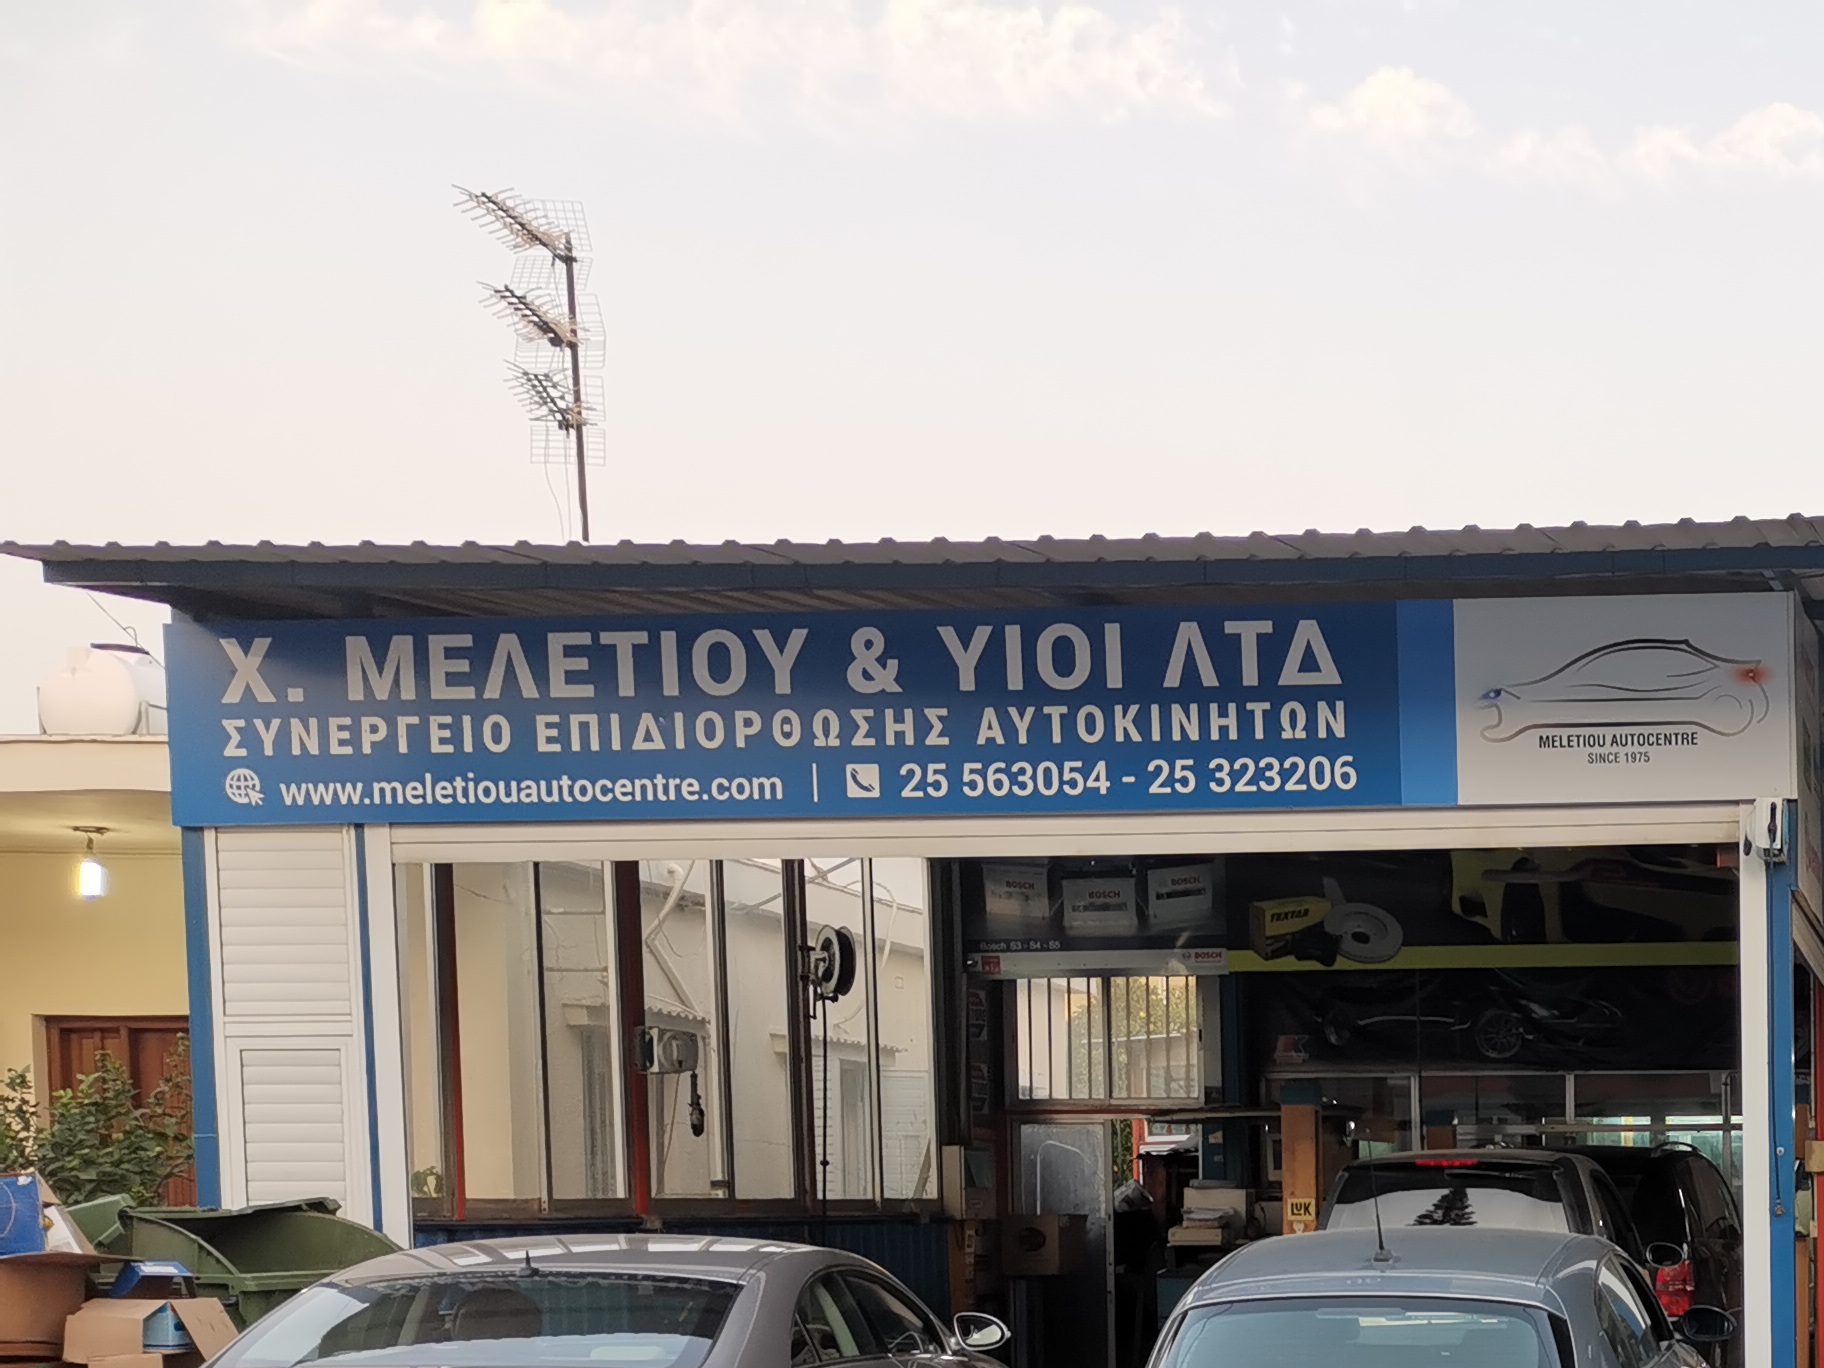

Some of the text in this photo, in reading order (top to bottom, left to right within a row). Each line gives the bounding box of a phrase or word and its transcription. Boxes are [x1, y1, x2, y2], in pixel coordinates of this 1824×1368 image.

[220, 619, 1342, 703] Χ. ΜΕΛΕΤΙΟΥ & ΥΙΟΙ ΛΤΔ
[222, 700, 1346, 758] ΣΥΝΕΡΓΕΙΟ ΕΠΙΔΙΟΡΘΩΣΗΣ ΑΥΤΟΚΙΝΗΤΩΝ
[1538, 732, 1698, 749] MELETIOU AUTOCENTRE
[1587, 751, 1650, 764] SINCE 1975
[900, 762, 949, 798] 25
[961, 760, 1111, 797] 563054
[1148, 759, 1196, 795] 25
[1208, 755, 1358, 793] 323206
[280, 772, 783, 806] www.meletiouautocentre.com
[1005, 880, 1035, 890] BOSCH
[1171, 875, 1200, 886] BOSCH
[1088, 890, 1121, 899] BOSCH
[1194, 951, 1222, 960] BOSCH
